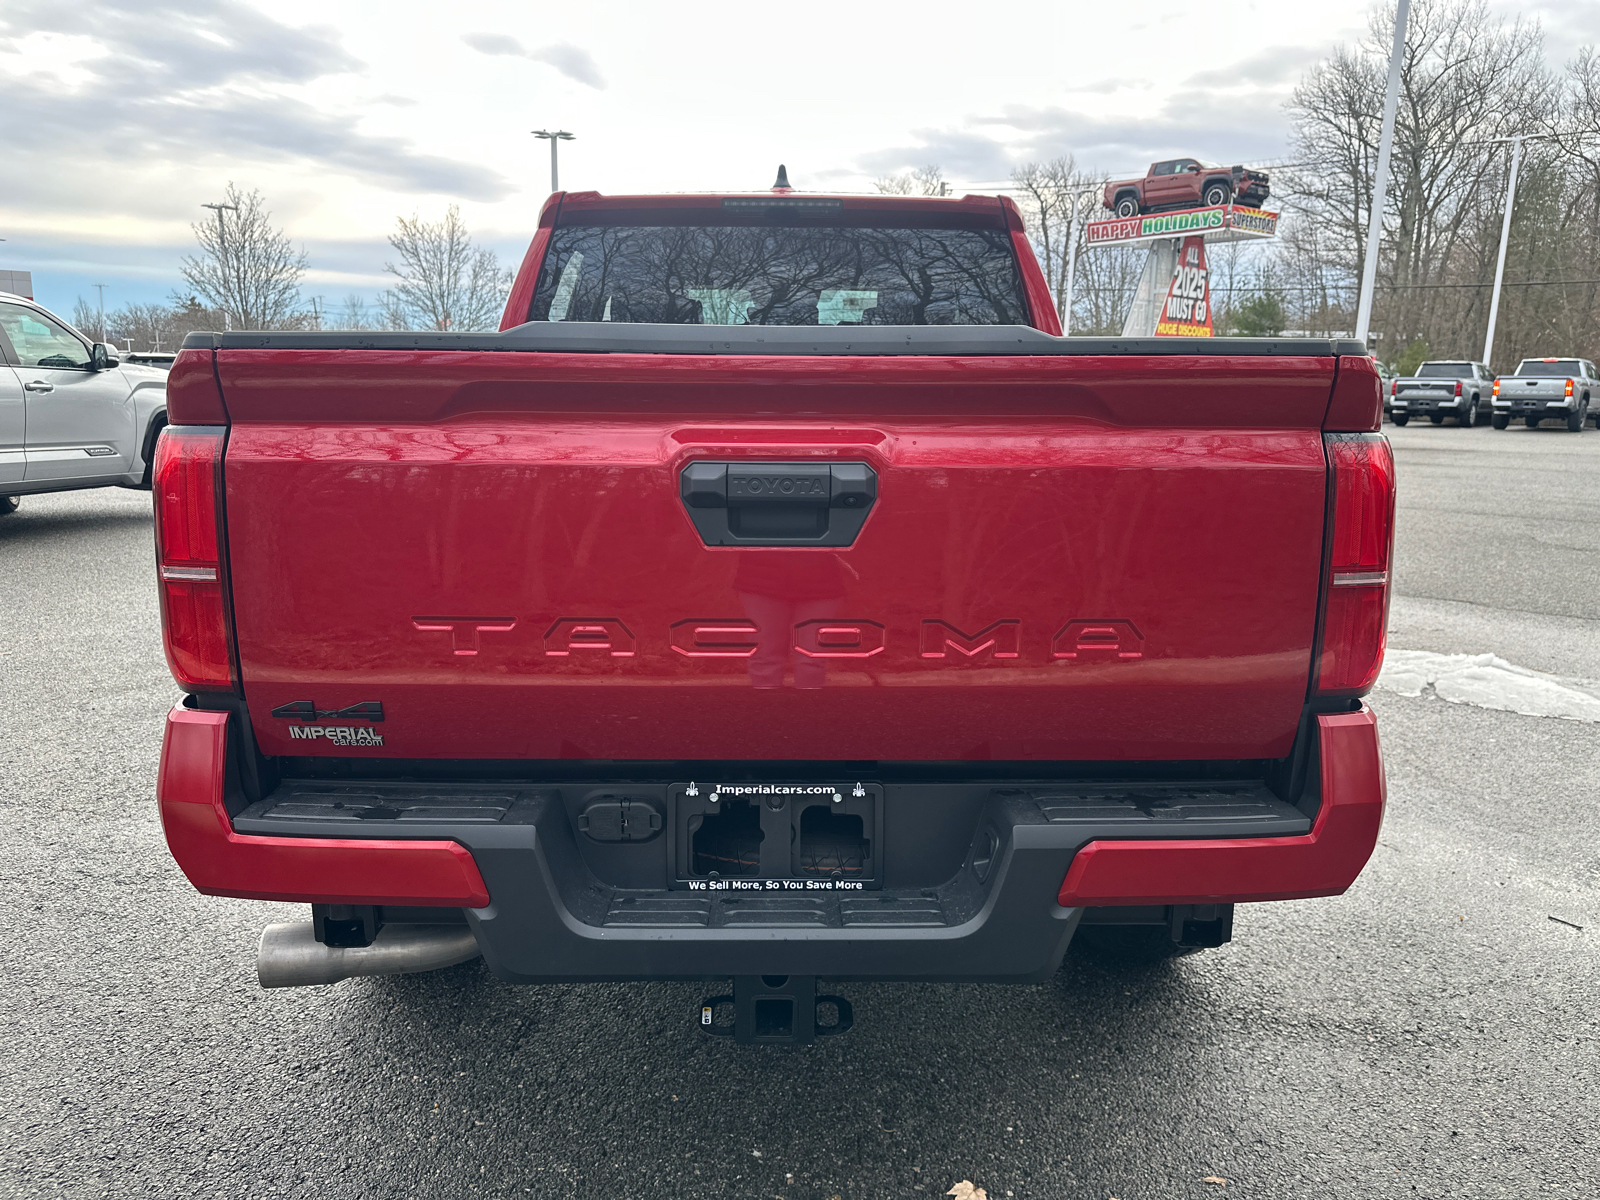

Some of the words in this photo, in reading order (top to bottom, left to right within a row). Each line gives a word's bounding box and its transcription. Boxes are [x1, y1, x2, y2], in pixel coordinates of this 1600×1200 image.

[1090, 220, 1140, 241] HAPPY
[1141, 209, 1224, 235] HOLIDAYS
[1231, 212, 1275, 232] SUPERSTORE
[1186, 247, 1199, 264] ALL
[1172, 265, 1207, 300] 2025
[1167, 297, 1195, 320] MUST
[1195, 300, 1207, 322] GO
[1157, 322, 1178, 334] HUGE
[1178, 325, 1211, 337] DISCOUNTS
[732, 478, 826, 495] TOYOTA
[411, 616, 1145, 658] TACOMA
[289, 725, 384, 740] IMPERIAL
[333, 739, 385, 747] cars.com
[715, 784, 836, 796] Imperialcars.com
[689, 881, 706, 890] We
[709, 881, 729, 890] Sell
[732, 881, 763, 891] More,
[765, 881, 780, 890] So
[782, 881, 803, 890] You
[806, 881, 832, 890] Save
[835, 881, 863, 890] More
